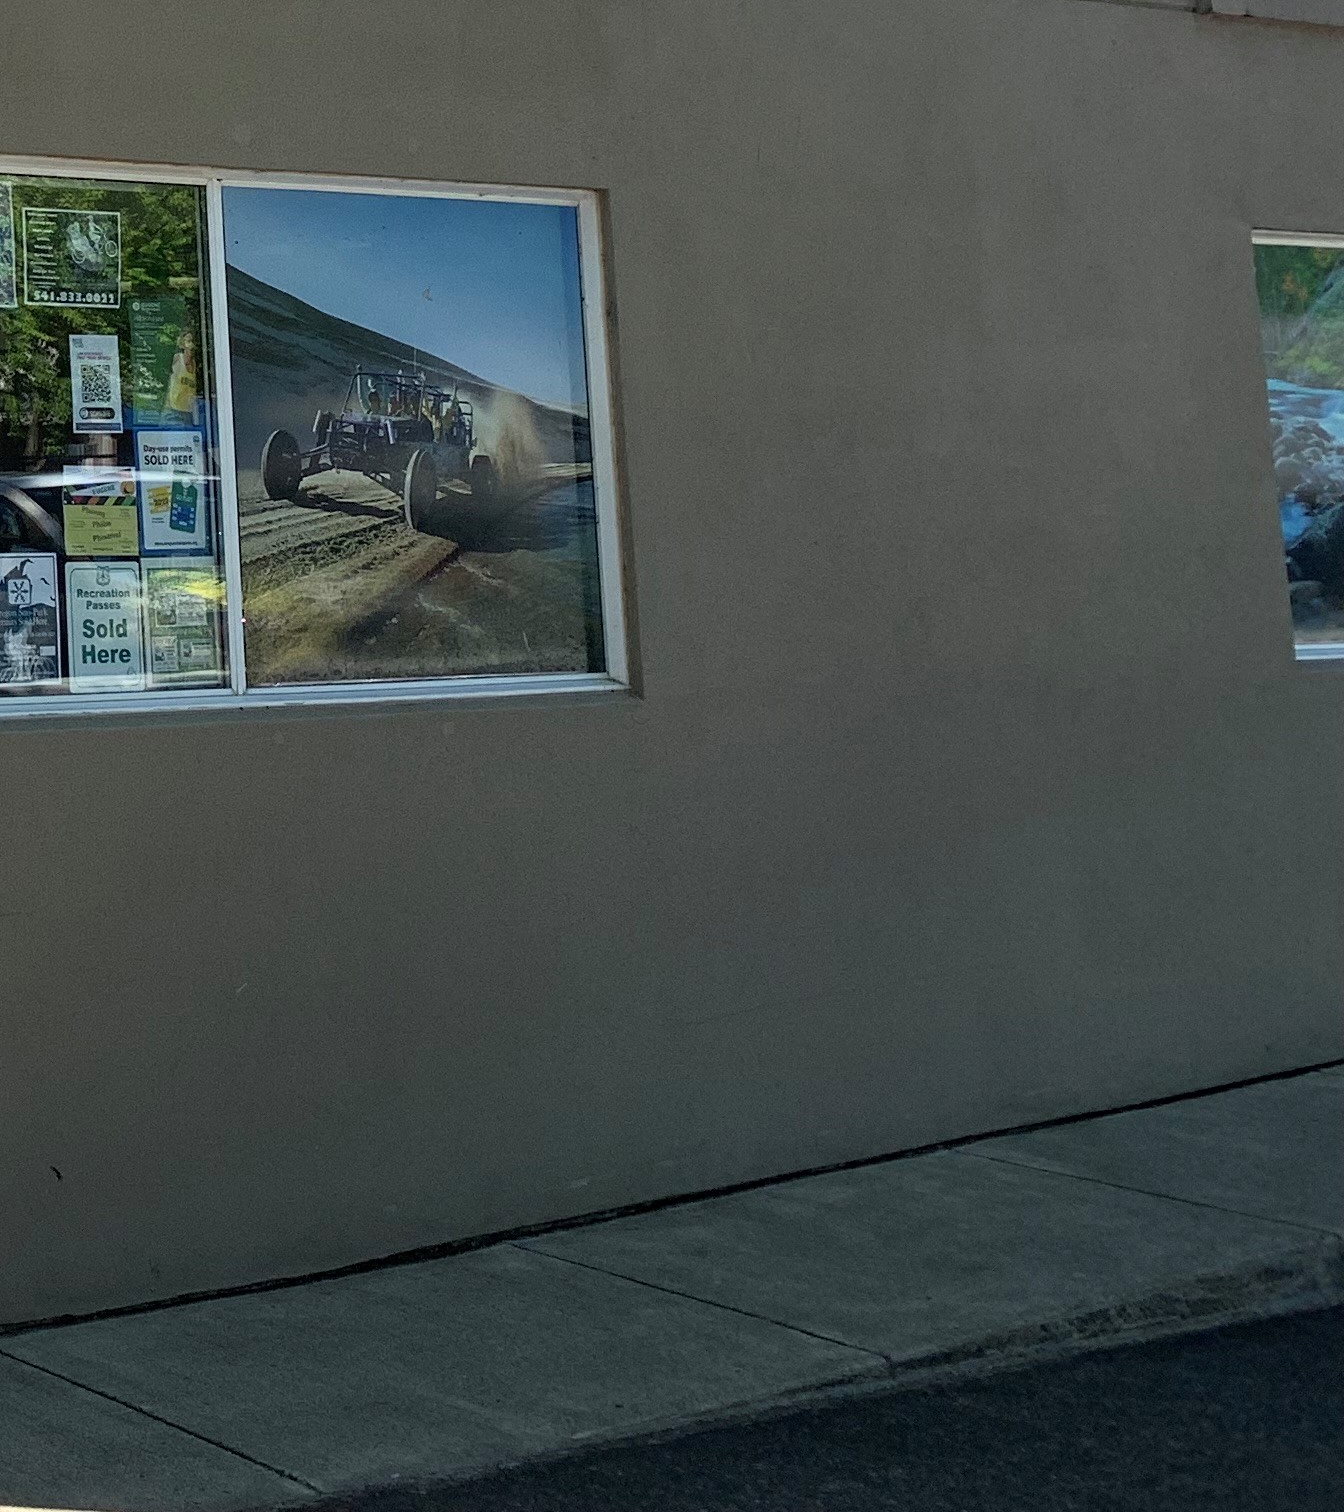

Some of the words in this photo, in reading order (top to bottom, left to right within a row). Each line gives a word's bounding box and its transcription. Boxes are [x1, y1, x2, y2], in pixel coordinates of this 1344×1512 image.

[143, 445, 169, 453] Day-use
[170, 445, 193, 453] permits
[144, 454, 169, 465] SOLD
[171, 454, 194, 465] HERE
[76, 588, 130, 598] Recreation
[85, 600, 121, 610] Passes
[82, 618, 128, 639] Sold
[81, 643, 131, 664] Here
